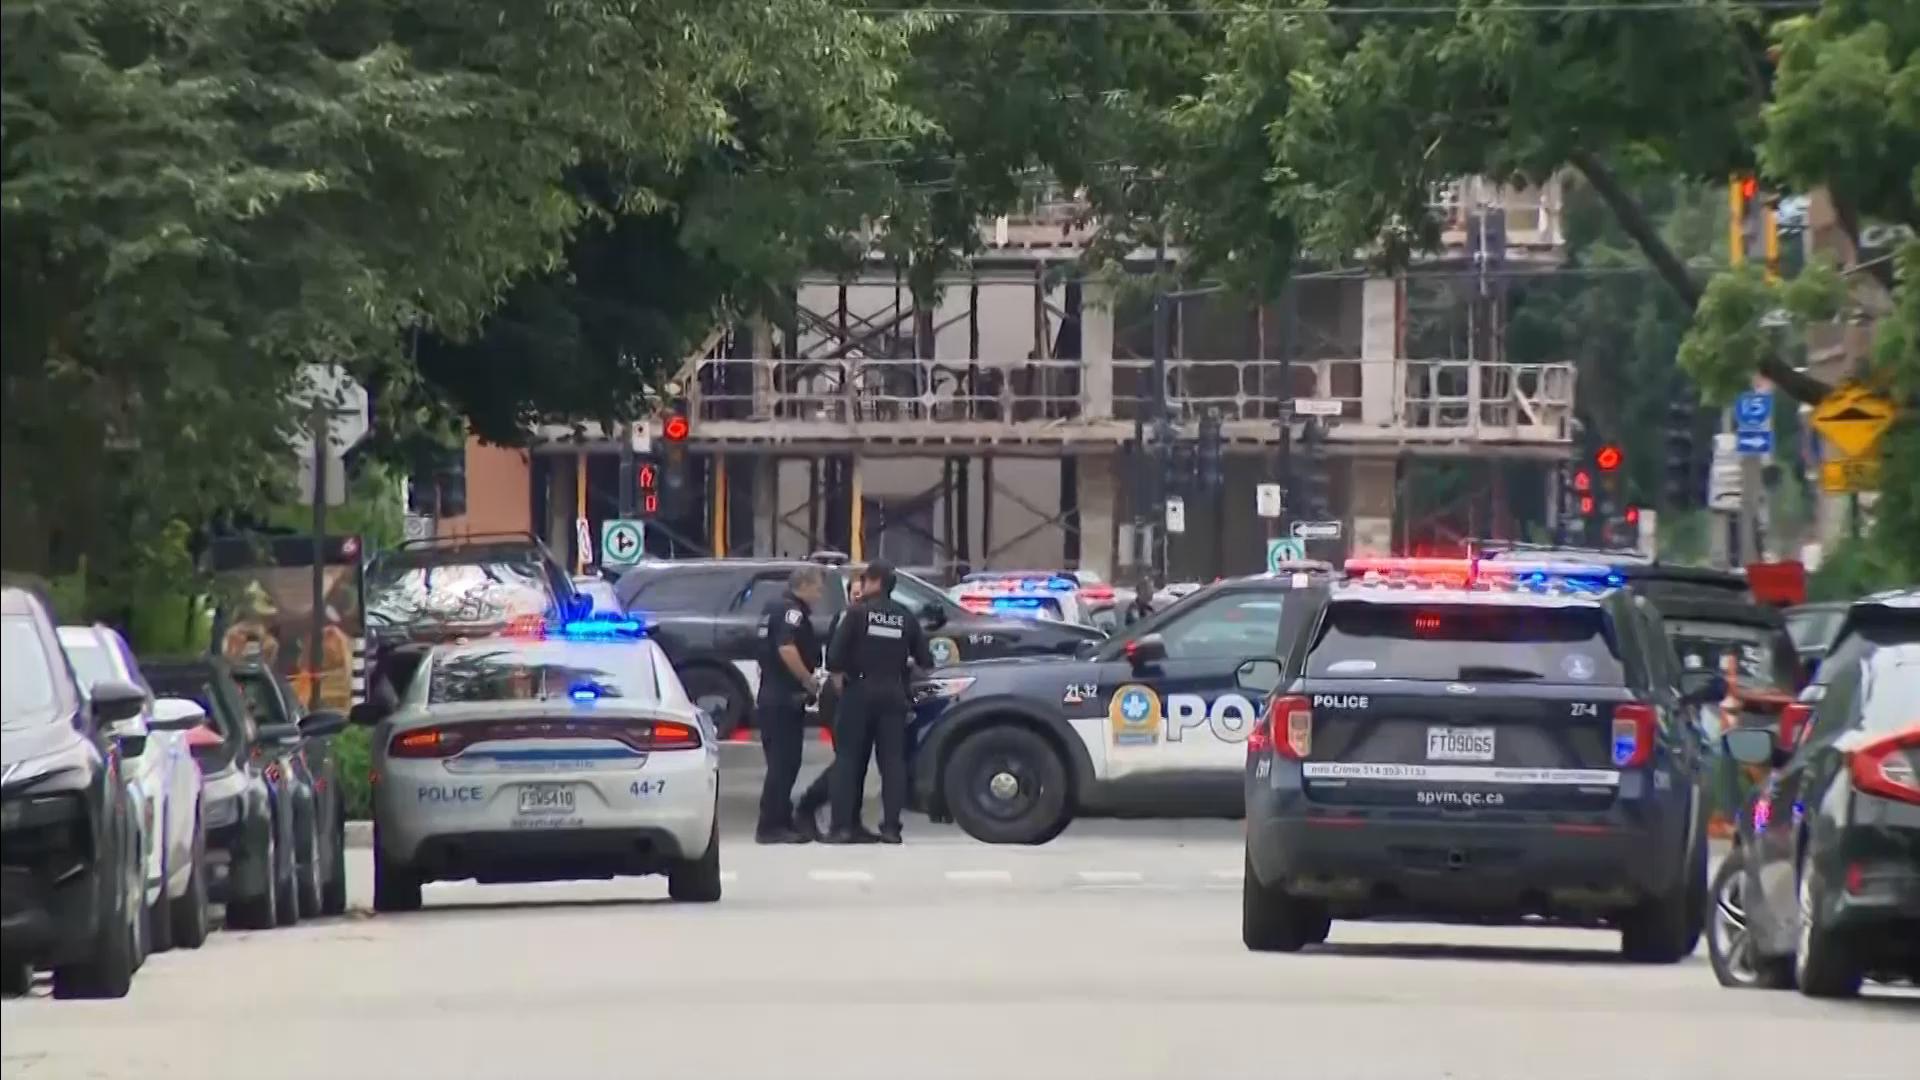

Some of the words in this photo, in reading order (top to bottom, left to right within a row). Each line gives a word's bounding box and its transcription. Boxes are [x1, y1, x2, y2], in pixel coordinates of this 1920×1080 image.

[868, 611, 904, 626] POLICE
[1313, 695, 1369, 709] POLICE
[1570, 703, 1598, 717] 27-4
[1166, 693, 1256, 743] PO
[418, 783, 483, 802] POLICE
[630, 780, 666, 797] 44-7
[1417, 791, 1504, 805] spvm.qc.ca
